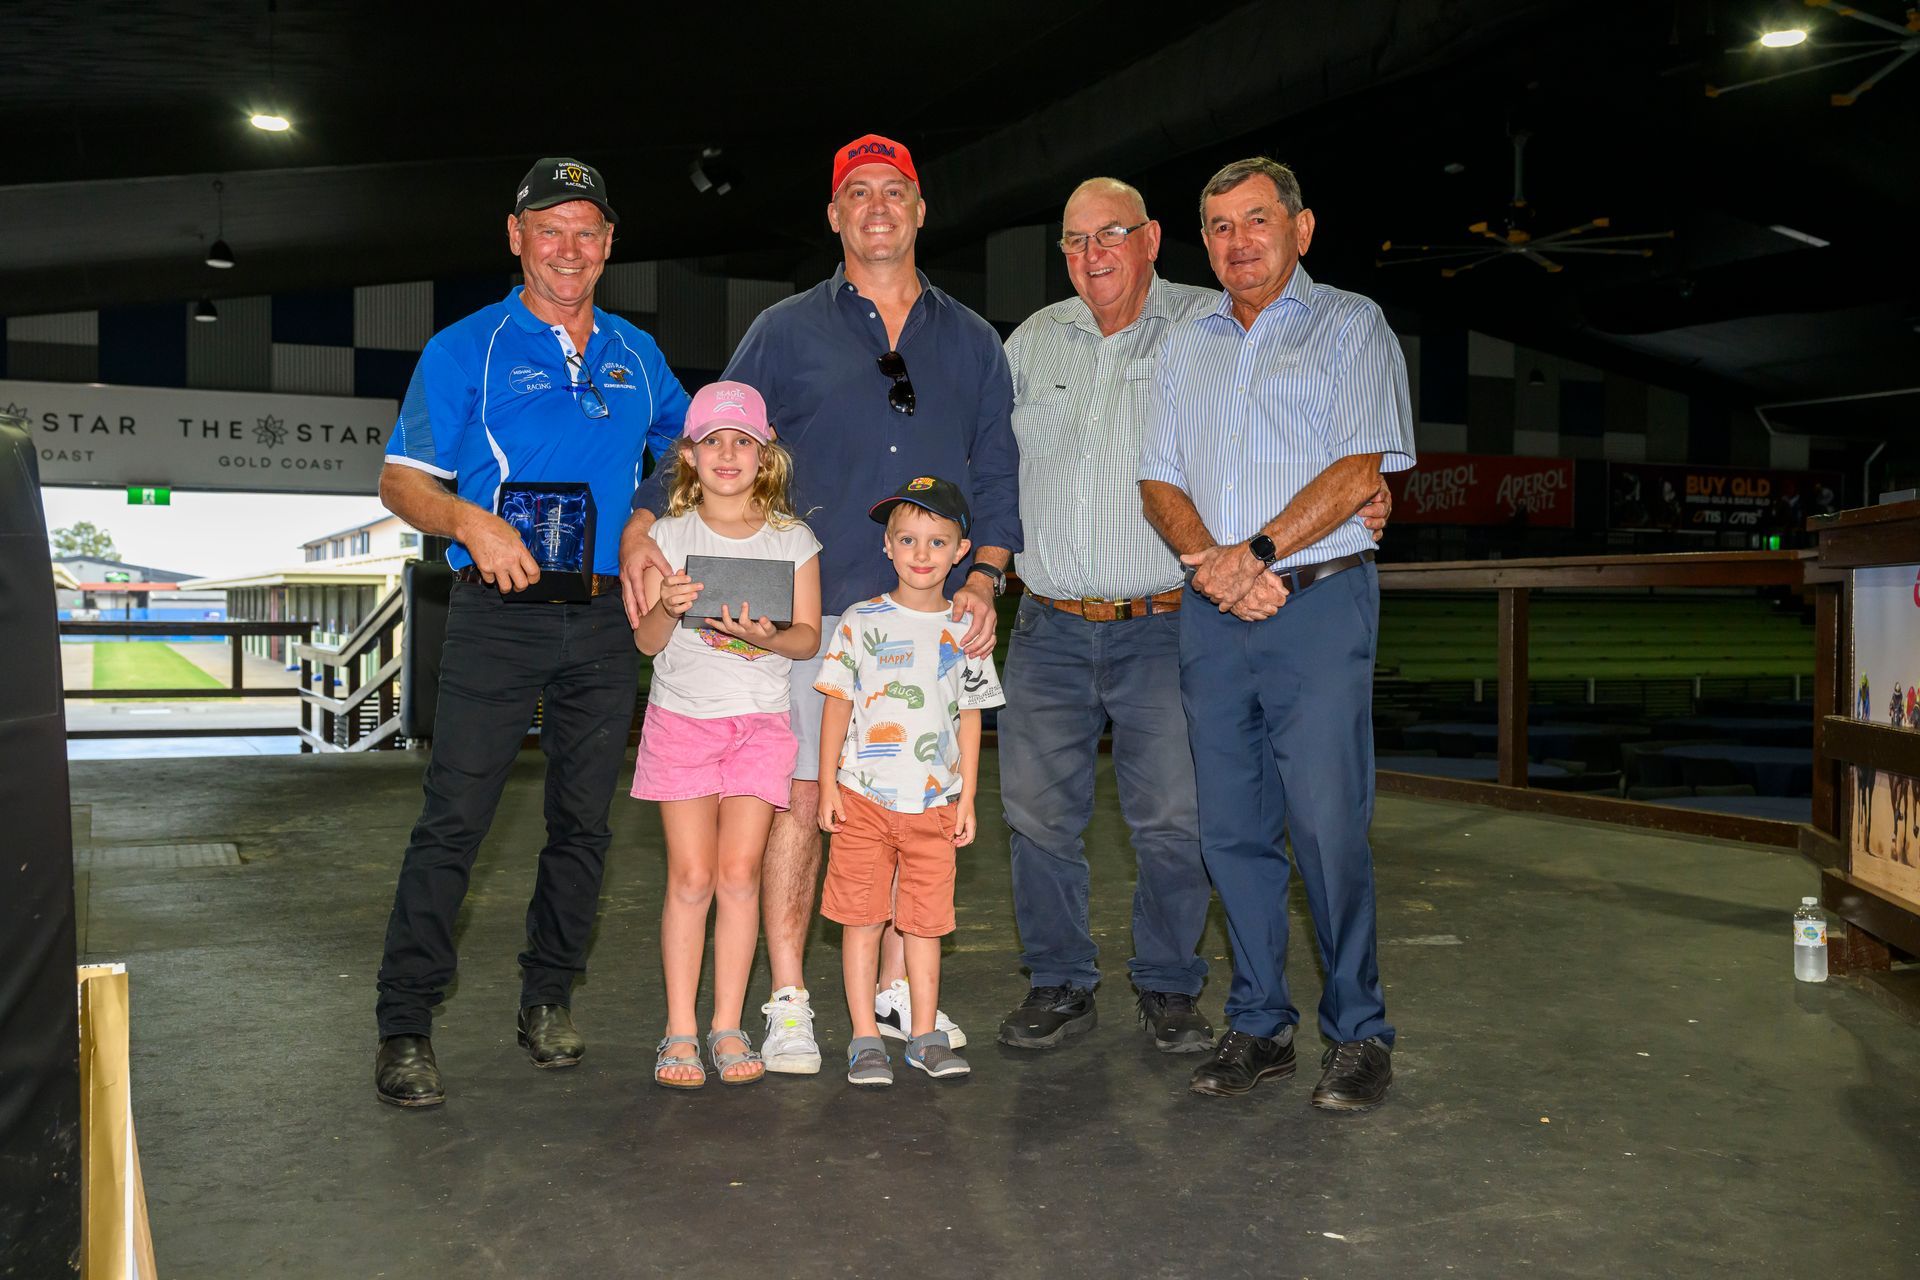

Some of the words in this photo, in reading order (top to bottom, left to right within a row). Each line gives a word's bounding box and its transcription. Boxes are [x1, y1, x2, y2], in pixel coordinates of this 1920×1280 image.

[848, 142, 896, 160] BOOM
[552, 166, 595, 187] JEWEL
[526, 382, 552, 391] RACING
[716, 388, 745, 399] MAGIC
[42, 412, 136, 436] STAR
[178, 418, 243, 440] THE
[296, 423, 382, 445] STAR
[41, 448, 95, 463] OAST
[218, 455, 272, 469] GOLD
[280, 457, 344, 471] COAST
[1403, 463, 1478, 502] APEROL
[1496, 468, 1568, 505] APEROL
[1685, 474, 1727, 496] BUY
[1731, 476, 1771, 497] QLD
[879, 651, 913, 665] HAPPY
